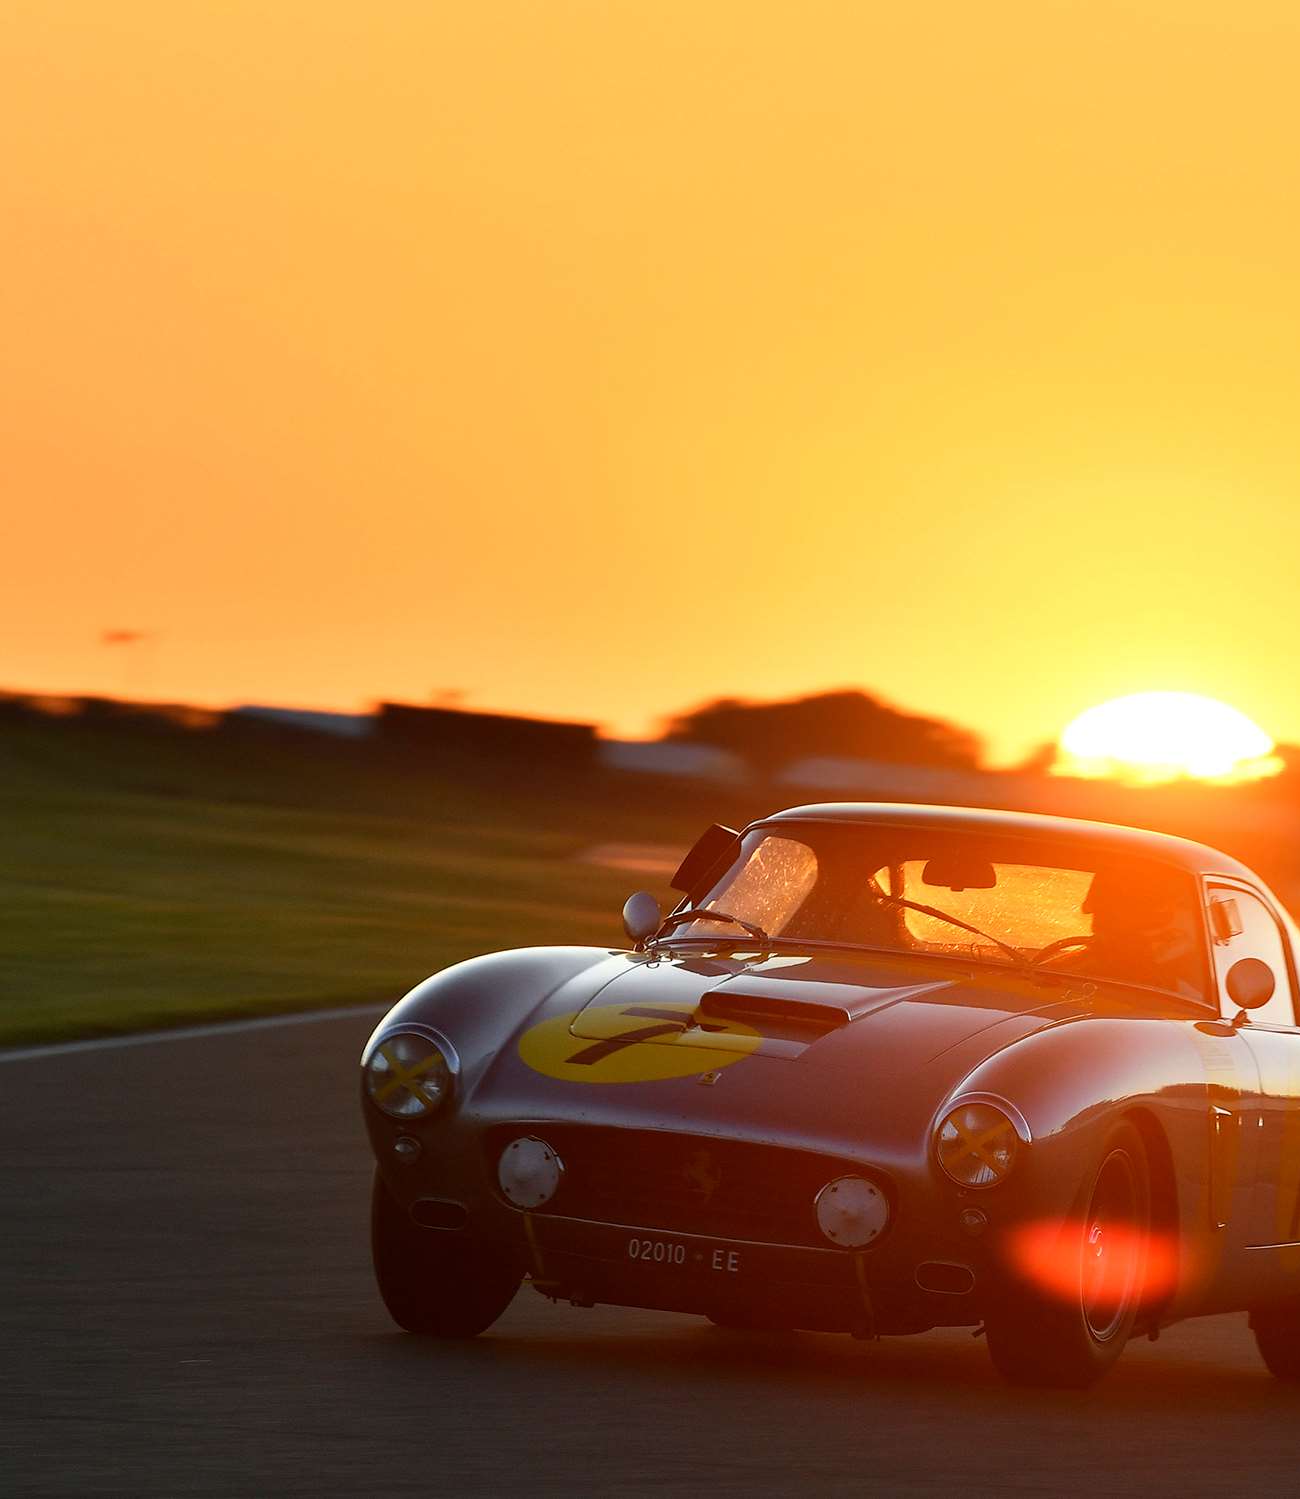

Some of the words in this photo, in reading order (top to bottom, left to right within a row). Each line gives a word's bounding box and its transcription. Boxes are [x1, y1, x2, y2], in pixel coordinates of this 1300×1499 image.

[563, 1006, 728, 1066] 7
[628, 1238, 686, 1264] 02010
[711, 1249, 740, 1272] EE
